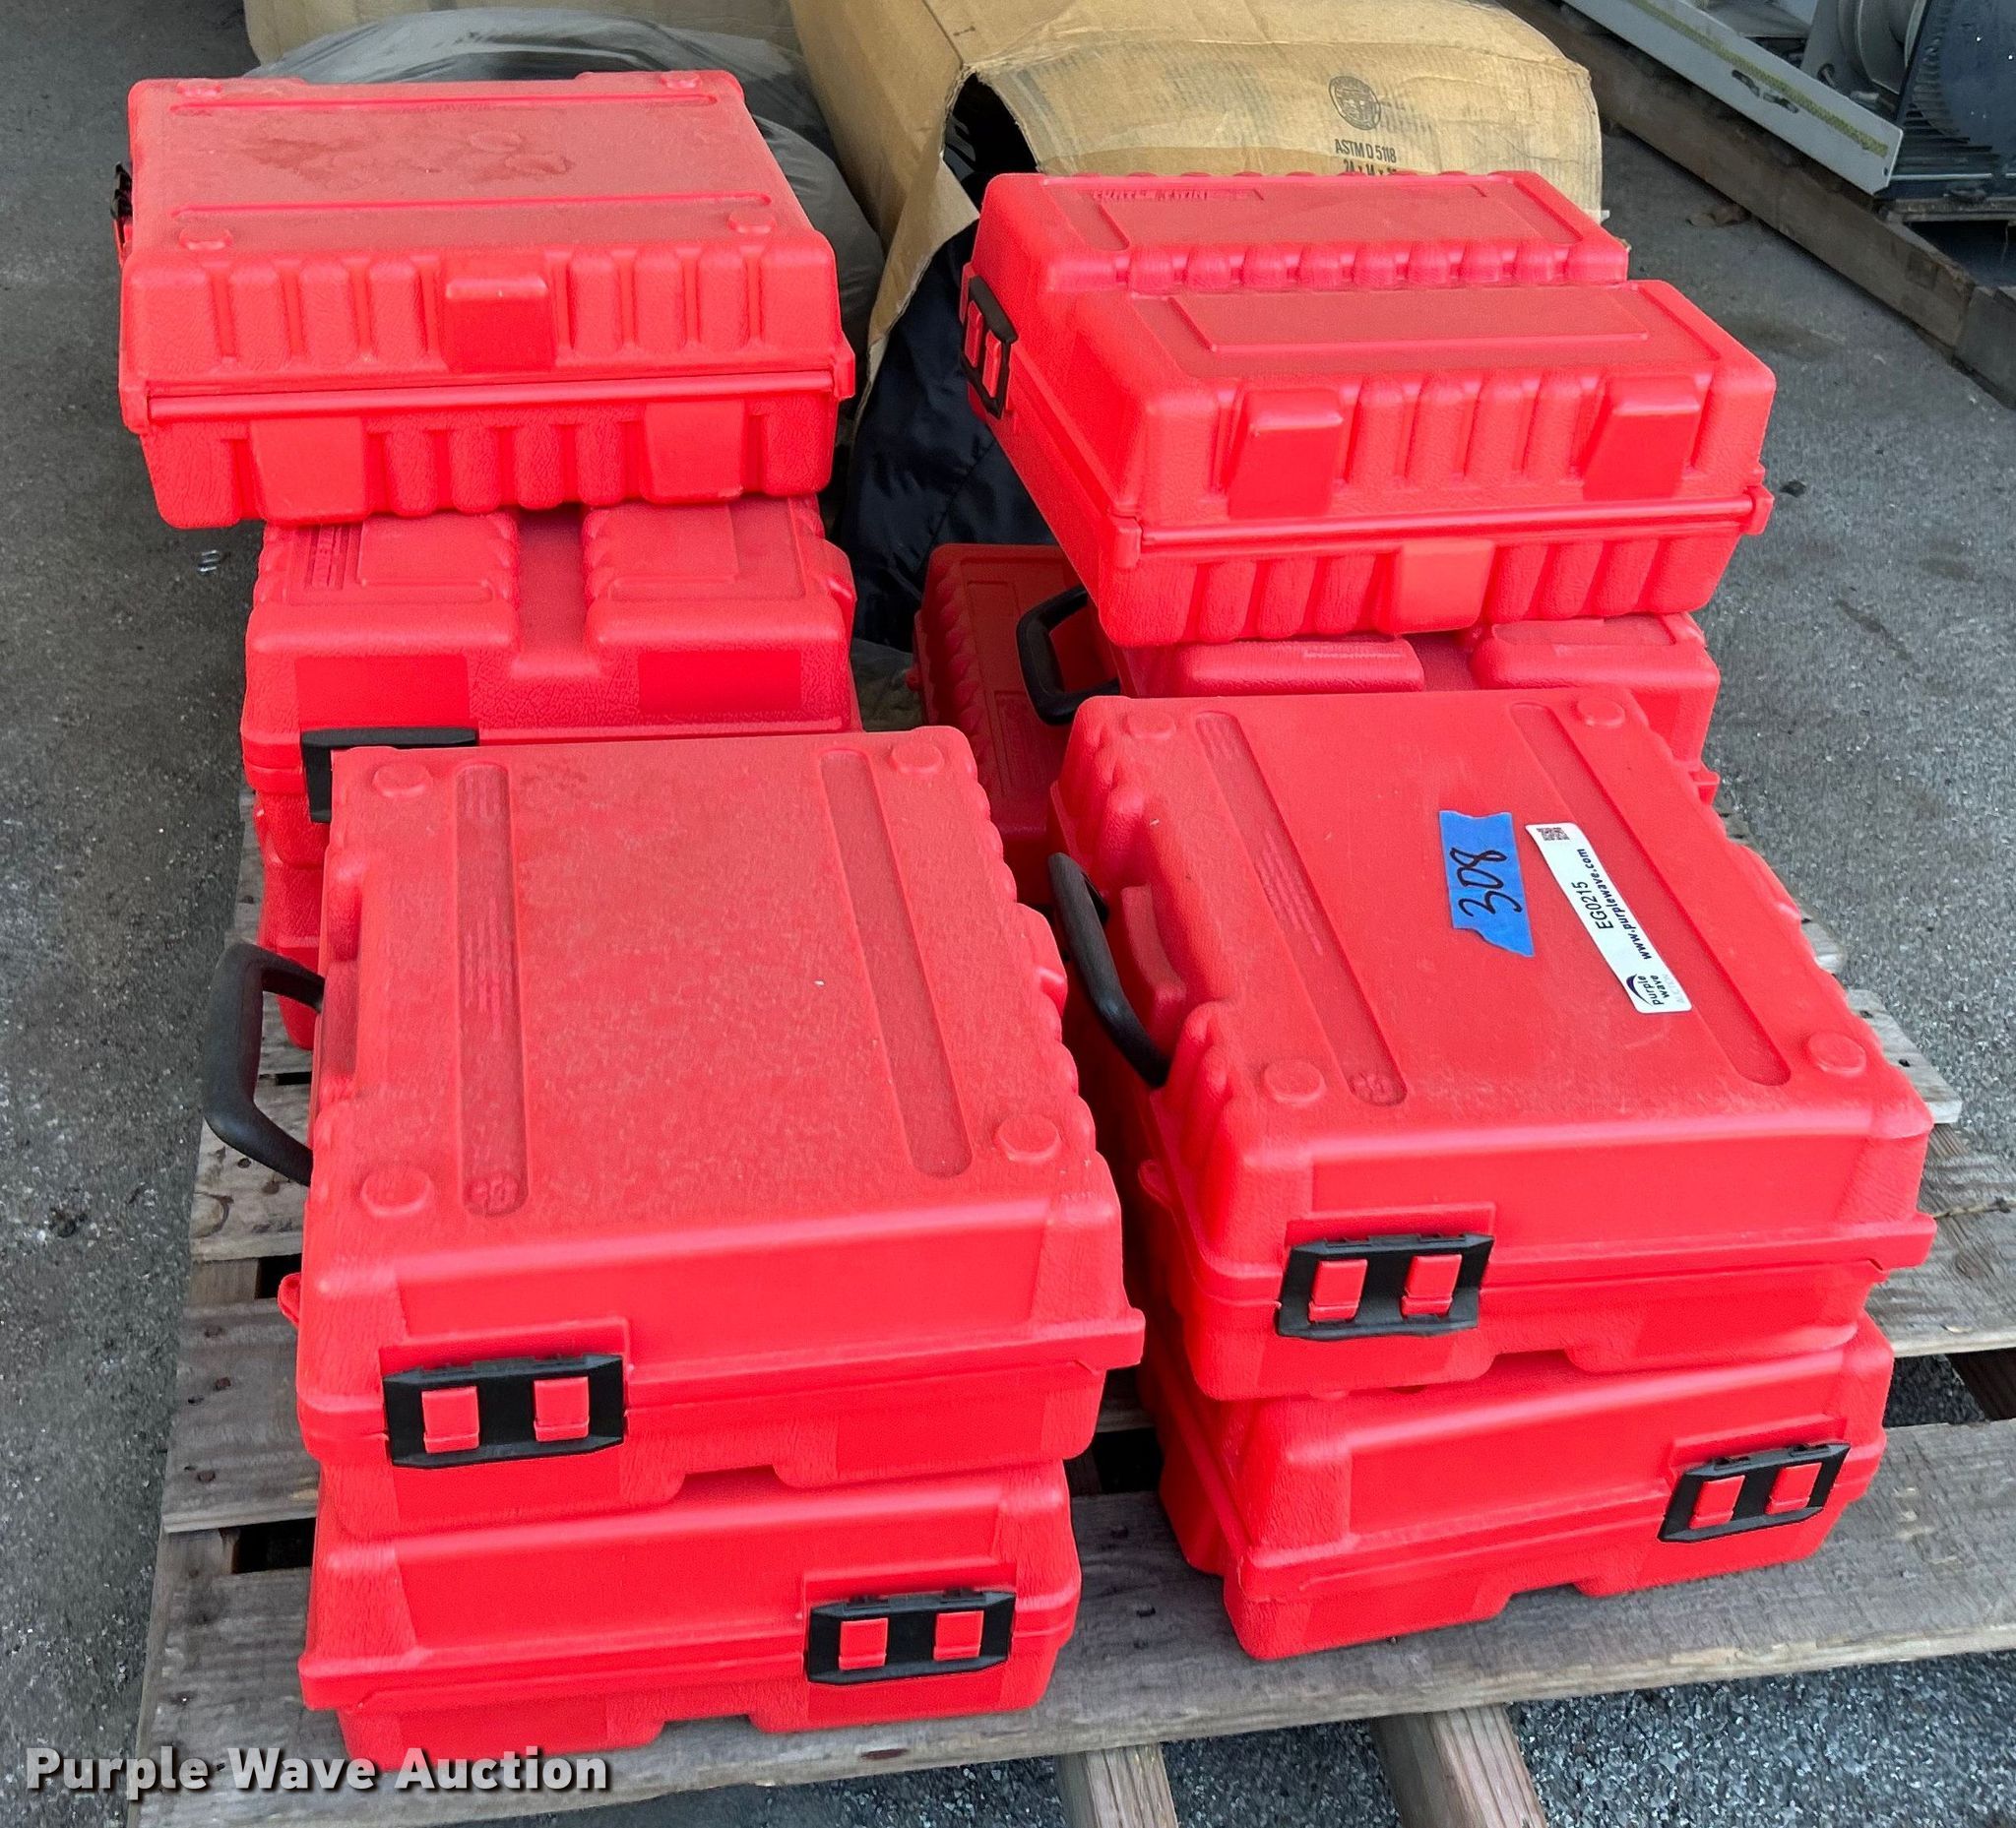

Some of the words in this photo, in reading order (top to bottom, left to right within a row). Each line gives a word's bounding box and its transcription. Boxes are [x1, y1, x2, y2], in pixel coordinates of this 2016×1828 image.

[1335, 139, 1364, 158] ASTM
[1365, 144, 1373, 158] D
[1375, 145, 1397, 163] 5118
[1450, 848, 1523, 917] 308
[1571, 880, 1614, 930] EG0215
[1576, 849, 1652, 960] www.purplewave.com
[1637, 976, 1665, 1005] purple
[1650, 975, 1670, 998] wave
